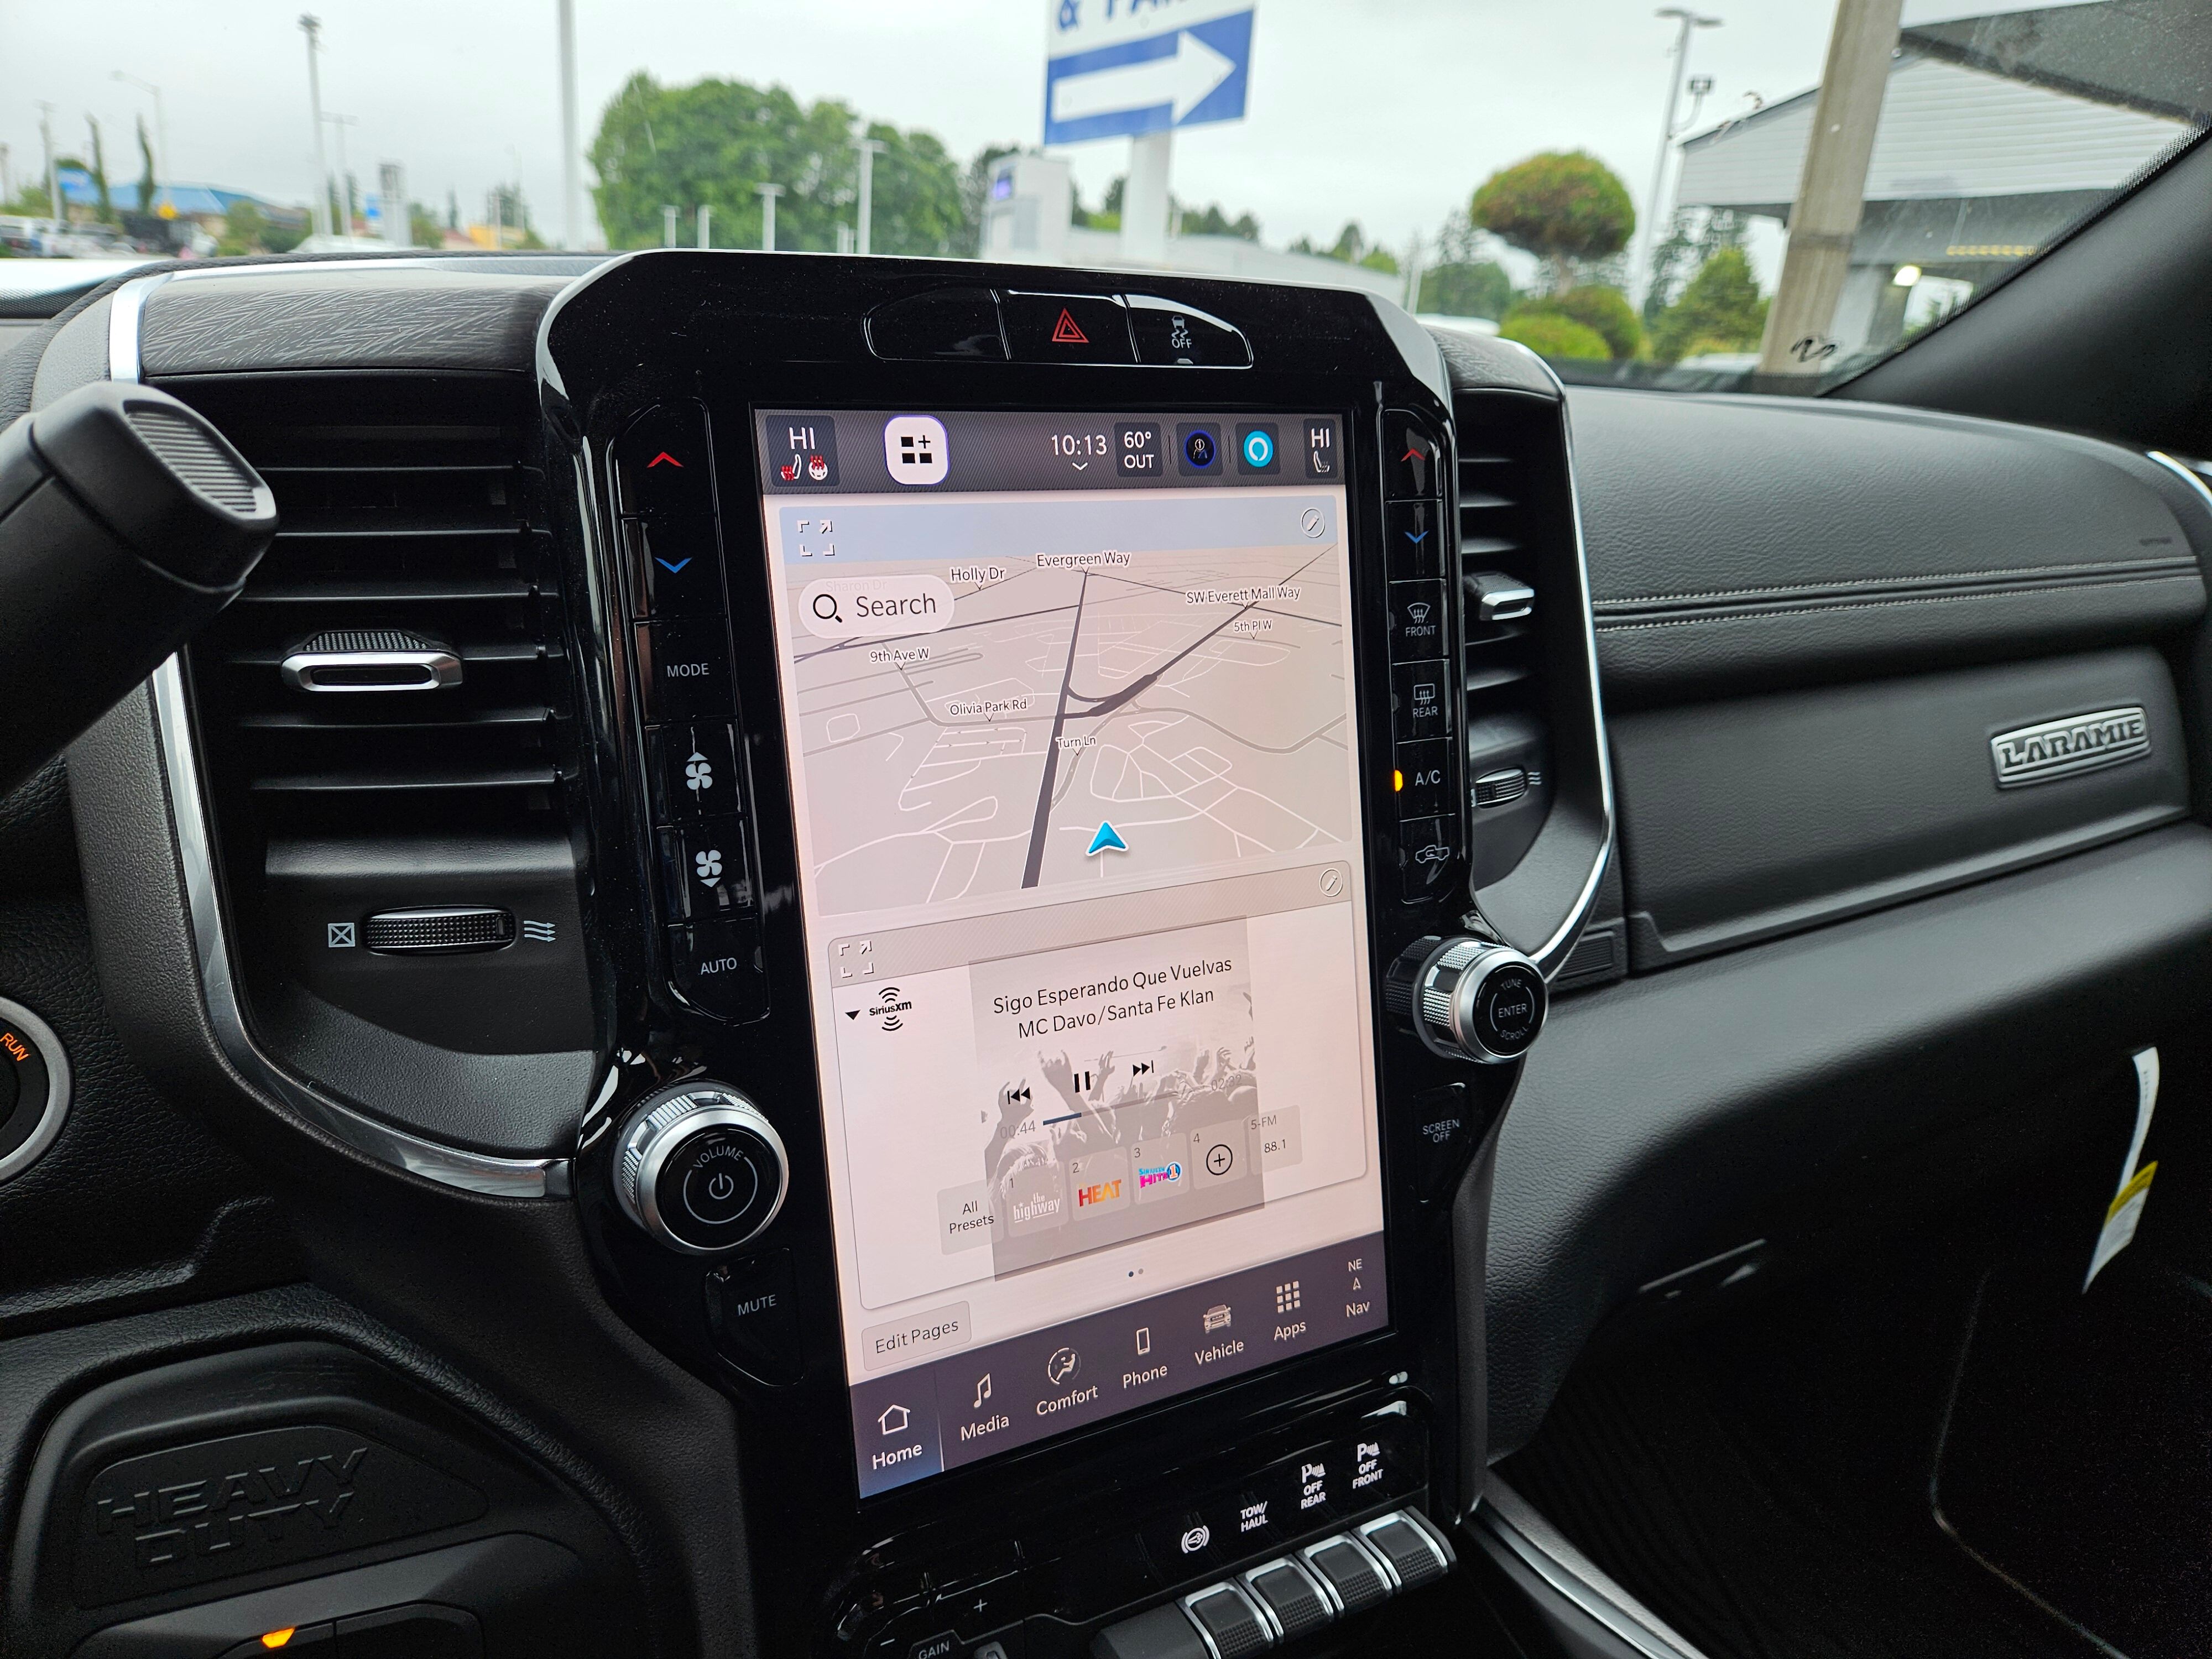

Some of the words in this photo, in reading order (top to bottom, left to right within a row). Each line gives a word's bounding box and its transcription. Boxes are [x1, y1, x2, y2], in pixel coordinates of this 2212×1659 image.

[1171, 338, 1192, 349] OFF
[789, 427, 816, 450] HI
[1051, 434, 1107, 456] 10:13
[1124, 431, 1152, 448] 60°
[1311, 427, 1329, 448] HI
[1124, 453, 1154, 468] OUT
[1037, 554, 1101, 568] Evergreen
[1104, 551, 1130, 567] Way
[951, 567, 986, 583] Holly
[989, 567, 1005, 580] Dr
[826, 581, 874, 592] Sharon
[876, 580, 887, 590] Dr
[1187, 592, 1207, 603] SW
[1208, 589, 1249, 602] Everett
[1251, 588, 1275, 601] Mall
[1276, 587, 1301, 601] Way
[857, 593, 936, 617] Search
[1234, 621, 1251, 632] 5th
[1253, 620, 1260, 631] Pl
[1261, 620, 1272, 630] W
[1405, 625, 1436, 637] FRONT
[870, 651, 890, 662] 9th
[894, 649, 915, 660] Ave
[917, 648, 930, 659] W
[667, 663, 709, 677] MODE
[950, 703, 982, 715] Olivia
[985, 701, 1009, 712] Park
[1013, 699, 1027, 709] Rd
[1412, 706, 1438, 718] REAR
[1057, 738, 1081, 748] Turn
[1084, 736, 1096, 745] Ln
[1999, 717, 2146, 769] LARAMIE
[1415, 769, 1441, 786] A/C
[700, 957, 737, 975] AUTO
[994, 995, 1032, 1015] Sigo
[1037, 975, 1129, 1006] Esperando
[1133, 970, 1167, 989] Que
[1170, 958, 1232, 981] Vuelvas
[1500, 978, 1522, 990] TUNE
[1019, 1018, 1048, 1039] MC
[1053, 1000, 1154, 1033] Davo/Santa
[1157, 993, 1177, 1011] Fe
[1181, 987, 1214, 1007] Klan
[1498, 1003, 1527, 1018] ENTER
[1500, 1026, 1530, 1040] SCROLL
[0, 1032, 29, 1061] RUN
[1212, 1074, 1243, 1091] 02:32
[1000, 1120, 1036, 1139] 00:44
[1251, 1115, 1277, 1130] 5-FM
[1422, 1118, 1460, 1135] SCREEN
[1193, 1133, 1200, 1144] 4
[1432, 1130, 1451, 1143] OFF
[1134, 1147, 1140, 1158] 3
[1264, 1139, 1286, 1153] 88.1
[693, 1145, 744, 1169] VOLUME
[1073, 1163, 1079, 1173] 2
[1010, 1177, 1014, 1188] 1
[1033, 1192, 1045, 1203] the
[1078, 1179, 1121, 1207] HEAT
[962, 1200, 978, 1215] All
[1013, 1197, 1060, 1221] highway
[950, 1214, 994, 1234] Presets
[1348, 1258, 1363, 1272] NE
[737, 1294, 777, 1316] MUTE
[1346, 1301, 1371, 1318] Nav
[875, 1332, 907, 1354] Edit
[911, 1320, 959, 1344] Pages
[1274, 1321, 1306, 1342] Apps
[1194, 1339, 1244, 1365] Vehicle
[1122, 1364, 1168, 1389] Phone
[1036, 1385, 1099, 1416] Comfort
[960, 1415, 1010, 1441] Media
[872, 1444, 924, 1470] Home
[1358, 1459, 1378, 1475] OFF
[1352, 1469, 1384, 1489] FRONT
[97, 1446, 368, 1536] HEAVY
[1303, 1480, 1323, 1496] OFF
[1301, 1491, 1326, 1510] REAR
[1240, 1500, 1268, 1520] TOW/
[135, 1491, 354, 1568] DUTY
[1241, 1515, 1269, 1532] HAUL
[919, 1640, 950, 1659] GAIN
